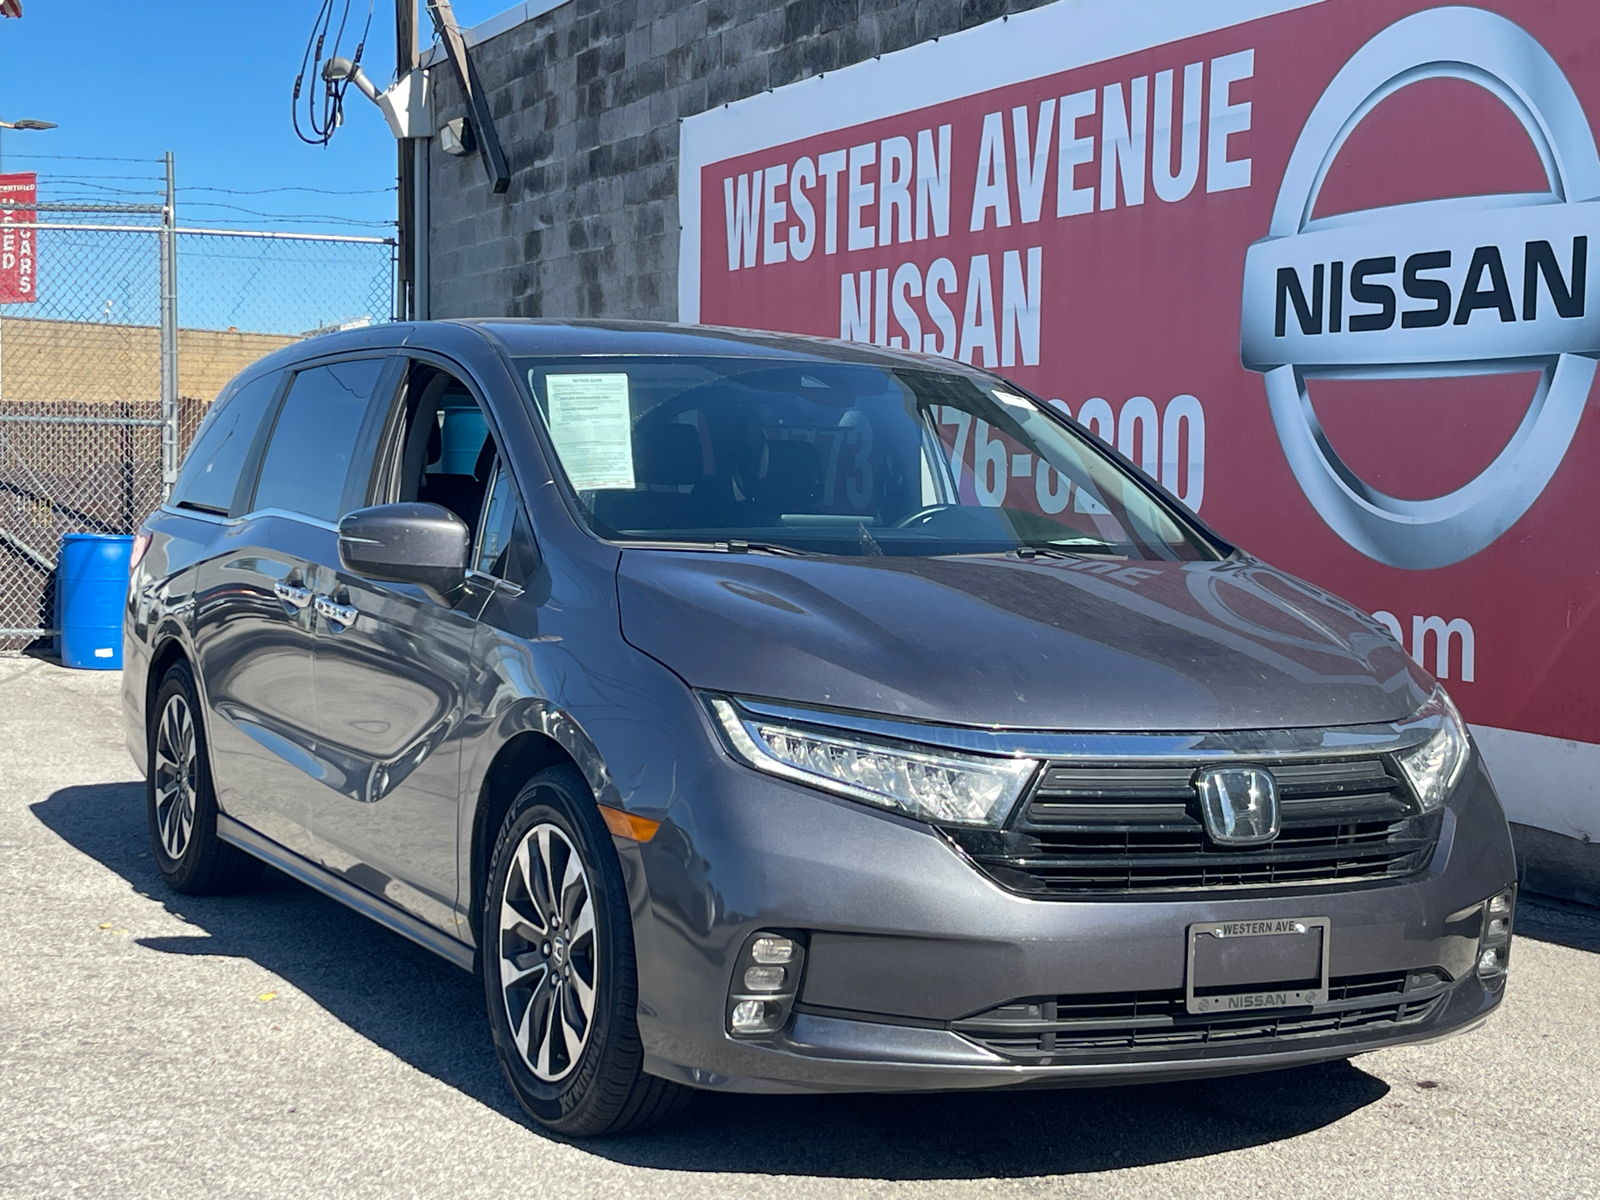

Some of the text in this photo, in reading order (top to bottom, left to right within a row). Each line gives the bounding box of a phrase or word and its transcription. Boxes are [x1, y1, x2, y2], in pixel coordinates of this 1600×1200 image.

[0, 183, 35, 193] CERTIFIED
[723, 48, 1255, 272] WESTERN AVENUE
[840, 246, 1043, 369] NISSAN
[1274, 235, 1588, 337] NISSAN
[484, 804, 517, 913] VELOCITY
[1223, 922, 1273, 935] WESTERN
[1228, 993, 1287, 1009] NISSAN
[559, 1026, 604, 1115] OMNIMAX
